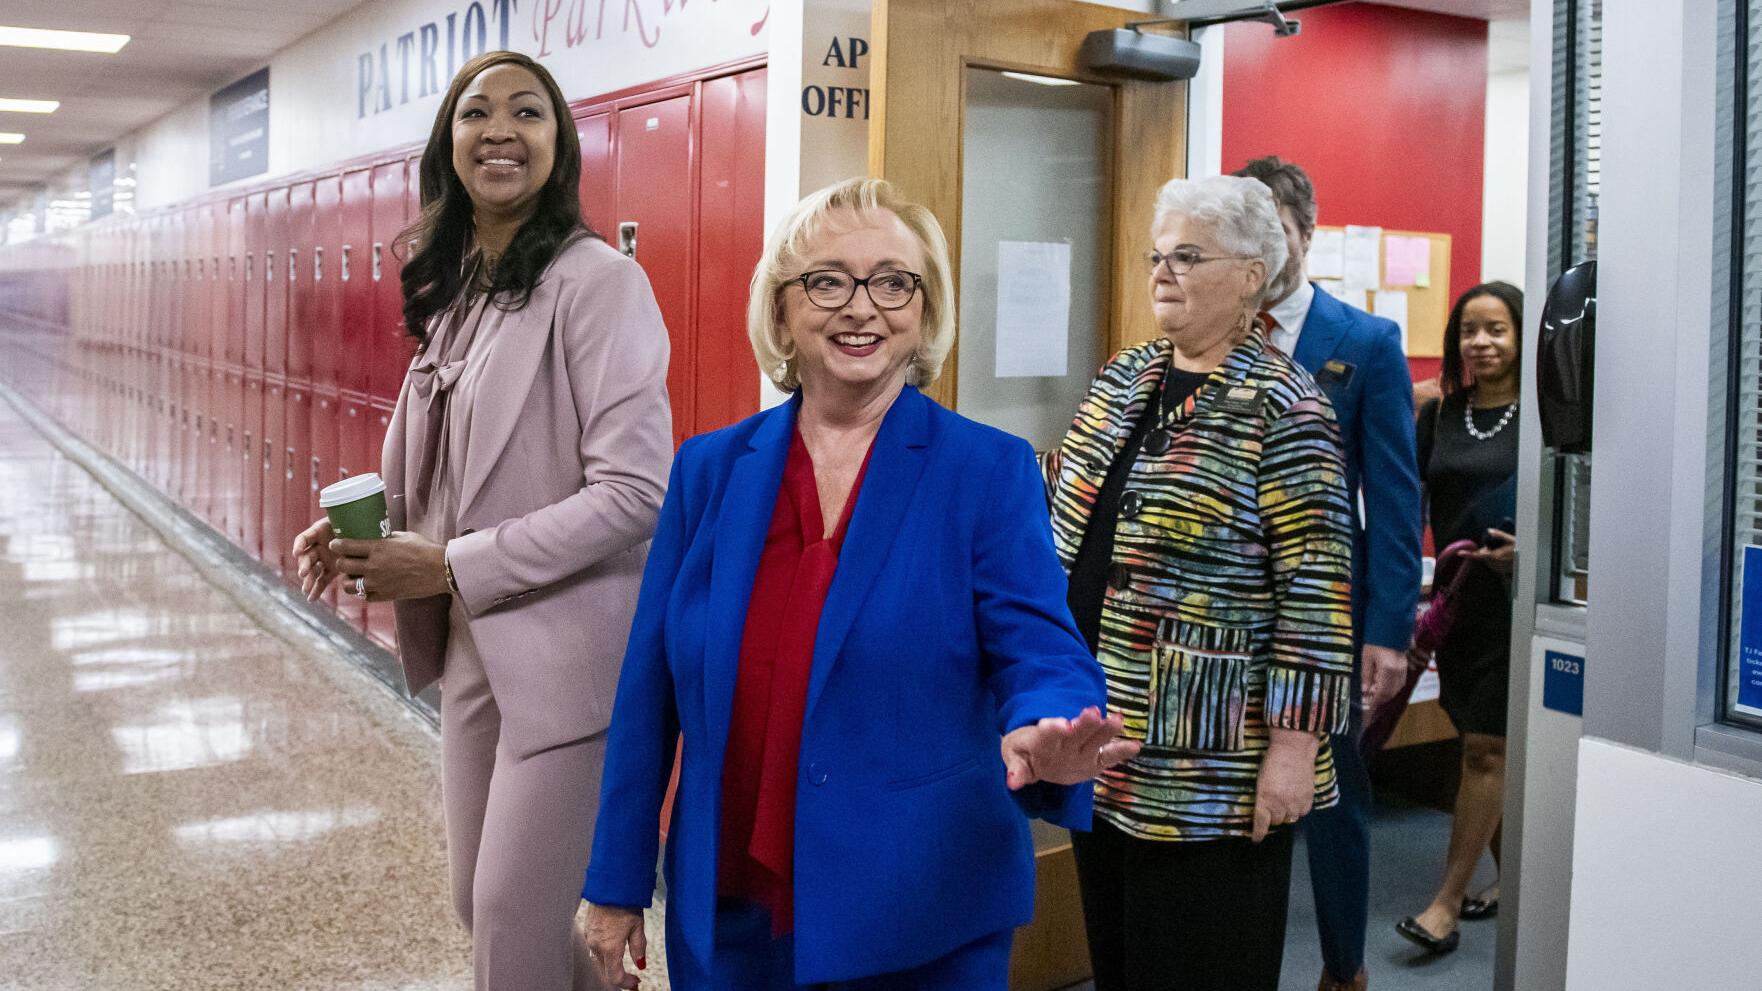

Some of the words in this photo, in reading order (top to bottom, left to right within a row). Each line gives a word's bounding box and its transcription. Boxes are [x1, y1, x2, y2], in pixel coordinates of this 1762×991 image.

[358, 0, 517, 119] PATRIOT
[822, 35, 869, 68] AP
[1552, 658, 1580, 674] 1023
